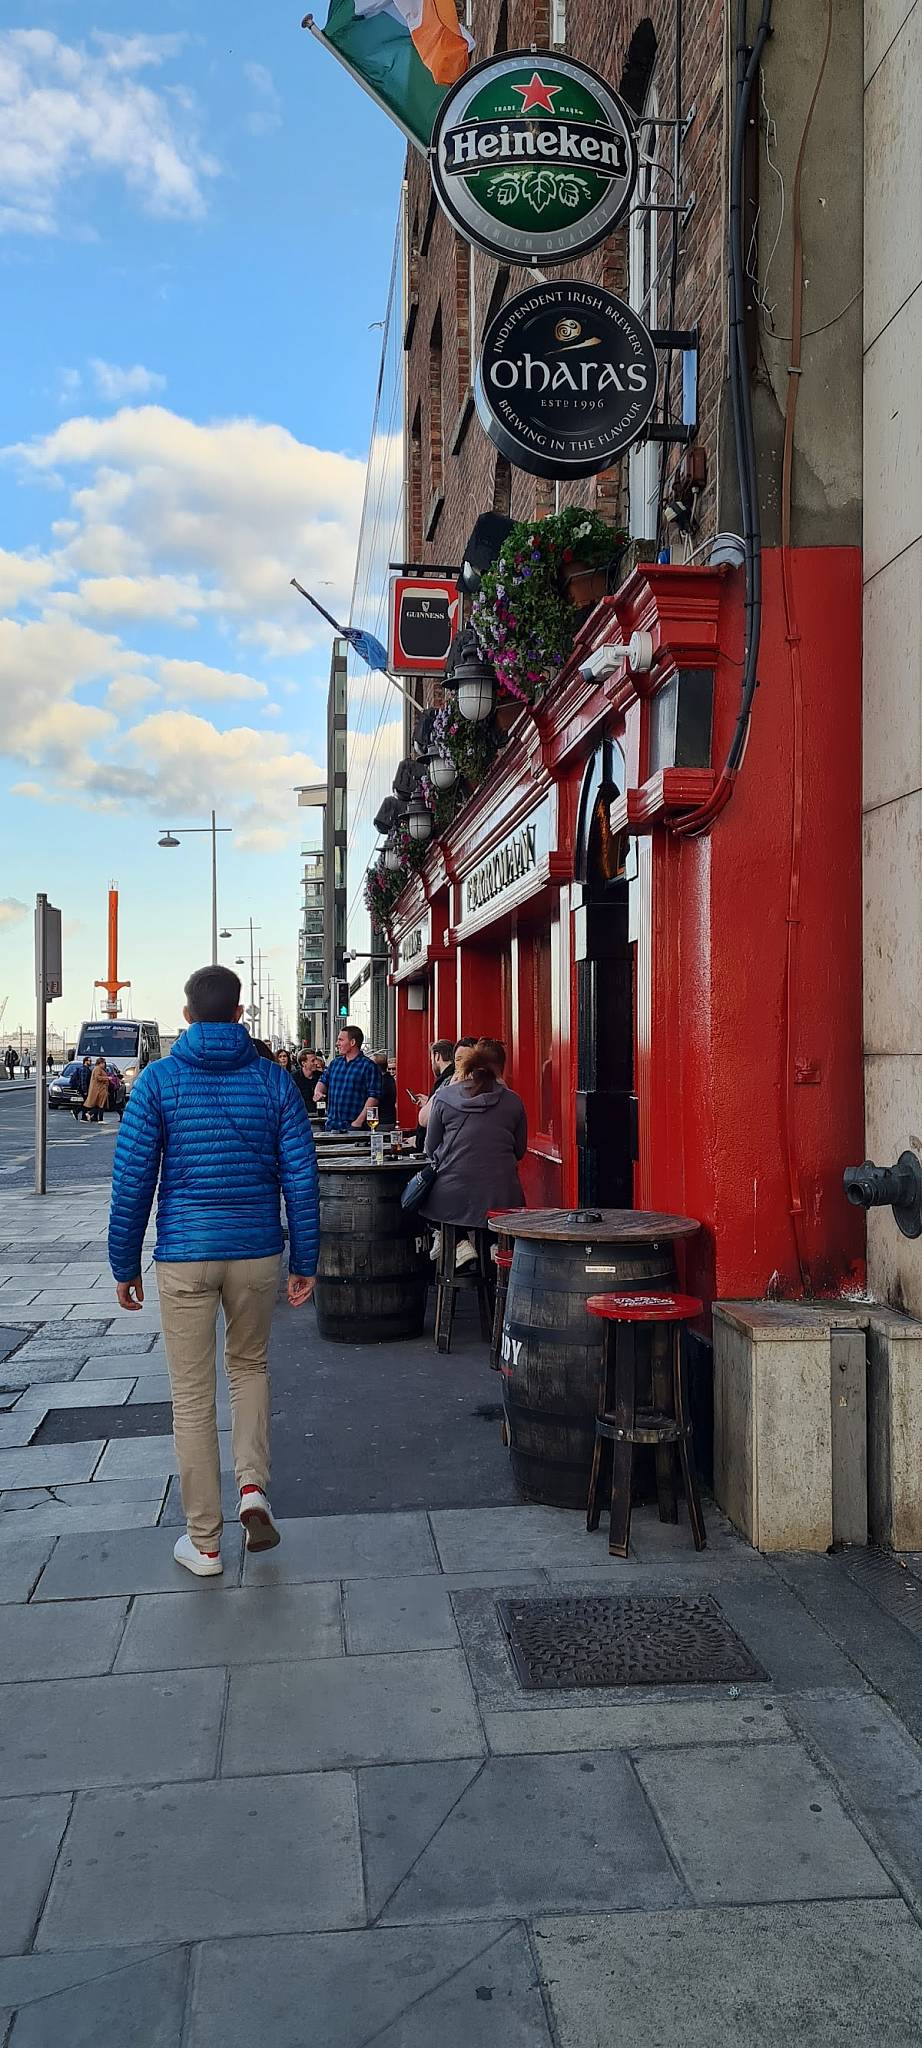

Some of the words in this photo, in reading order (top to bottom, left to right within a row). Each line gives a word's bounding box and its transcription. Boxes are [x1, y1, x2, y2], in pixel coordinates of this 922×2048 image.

[465, 59, 540, 94] RIGINAL
[451, 125, 620, 167] Heineken
[465, 207, 533, 250] REMIUM
[546, 206, 609, 250] QUALITY
[494, 292, 564, 353] INDEPENDENT
[568, 292, 603, 310] IRISH
[605, 306, 644, 356] BREWERY
[498, 399, 547, 445] BREWING
[550, 439, 565, 451] IN
[569, 439, 597, 451] THE
[598, 401, 642, 446] FLAVOUR
[574, 398, 605, 411] 1996
[406, 610, 445, 620] GUINNESS
